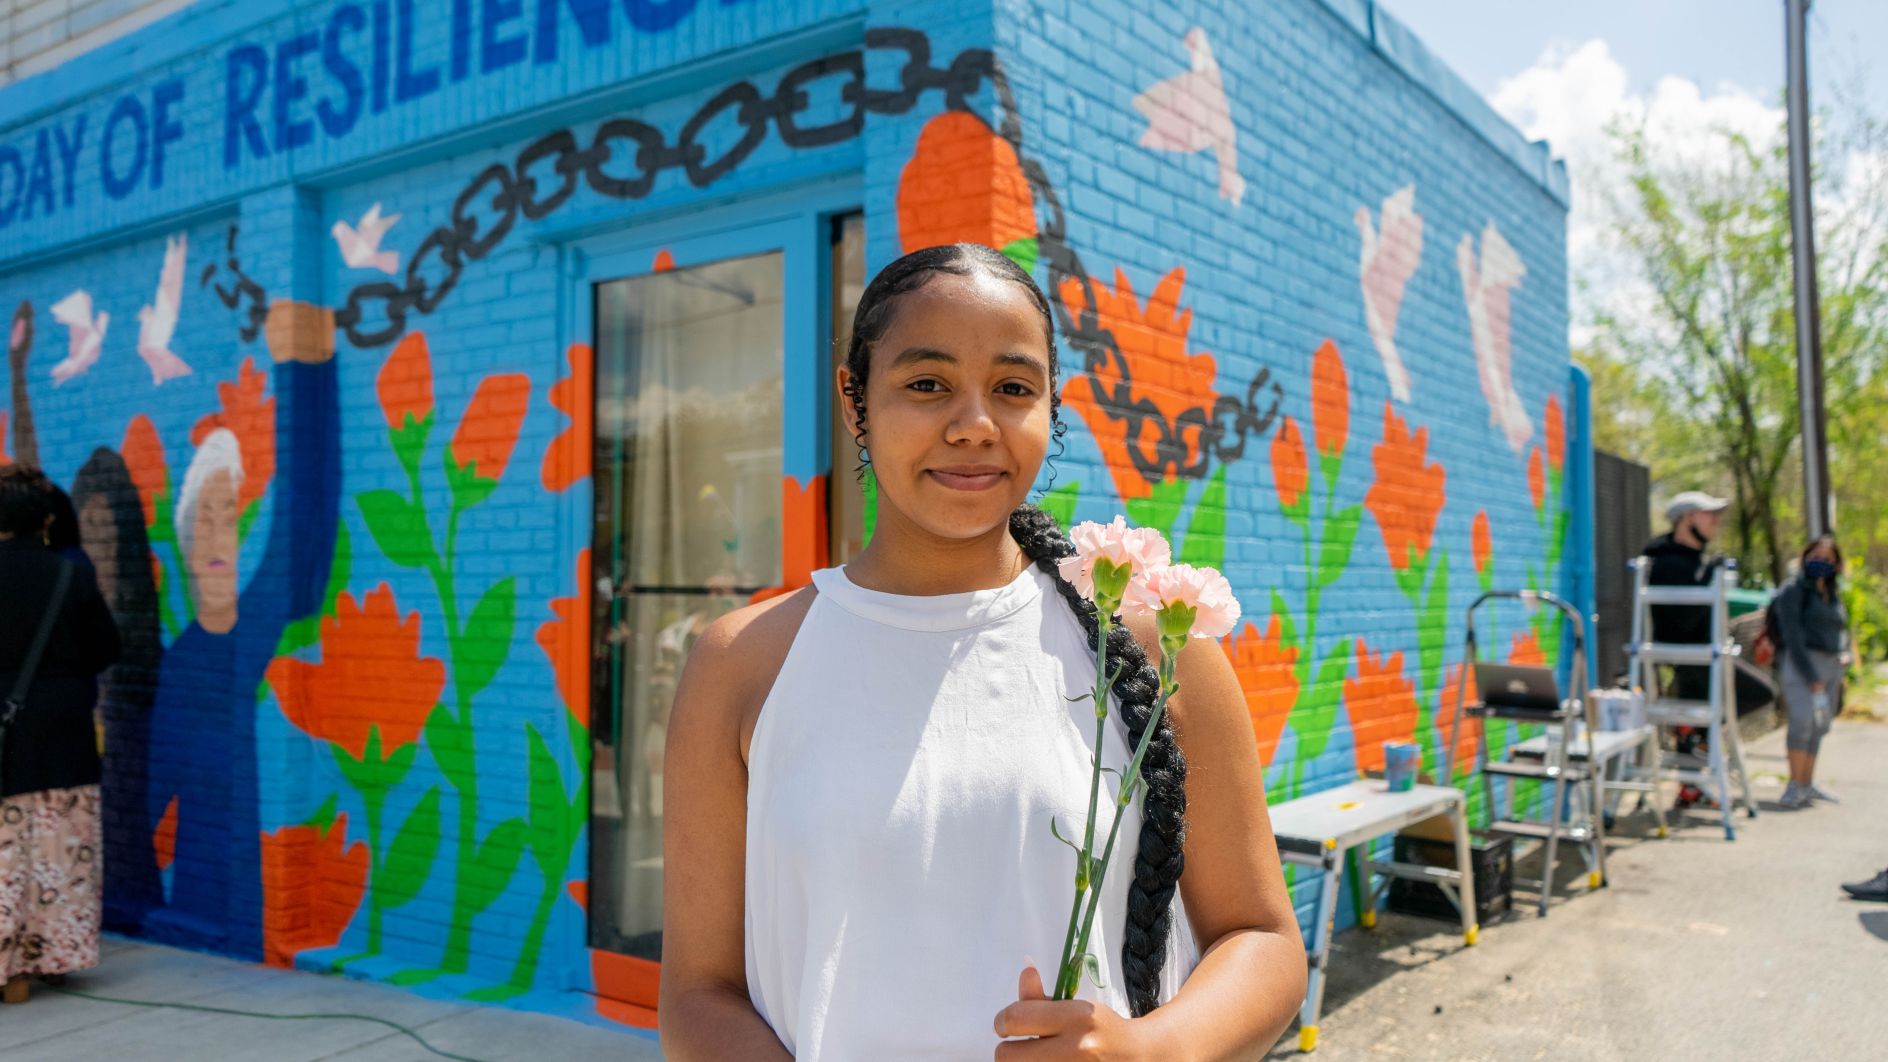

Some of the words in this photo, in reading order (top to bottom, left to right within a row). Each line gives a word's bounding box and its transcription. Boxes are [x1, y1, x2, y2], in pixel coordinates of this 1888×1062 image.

[0, 113, 88, 228] DAY
[101, 80, 186, 200] OF
[223, 0, 738, 169] RESILIE
